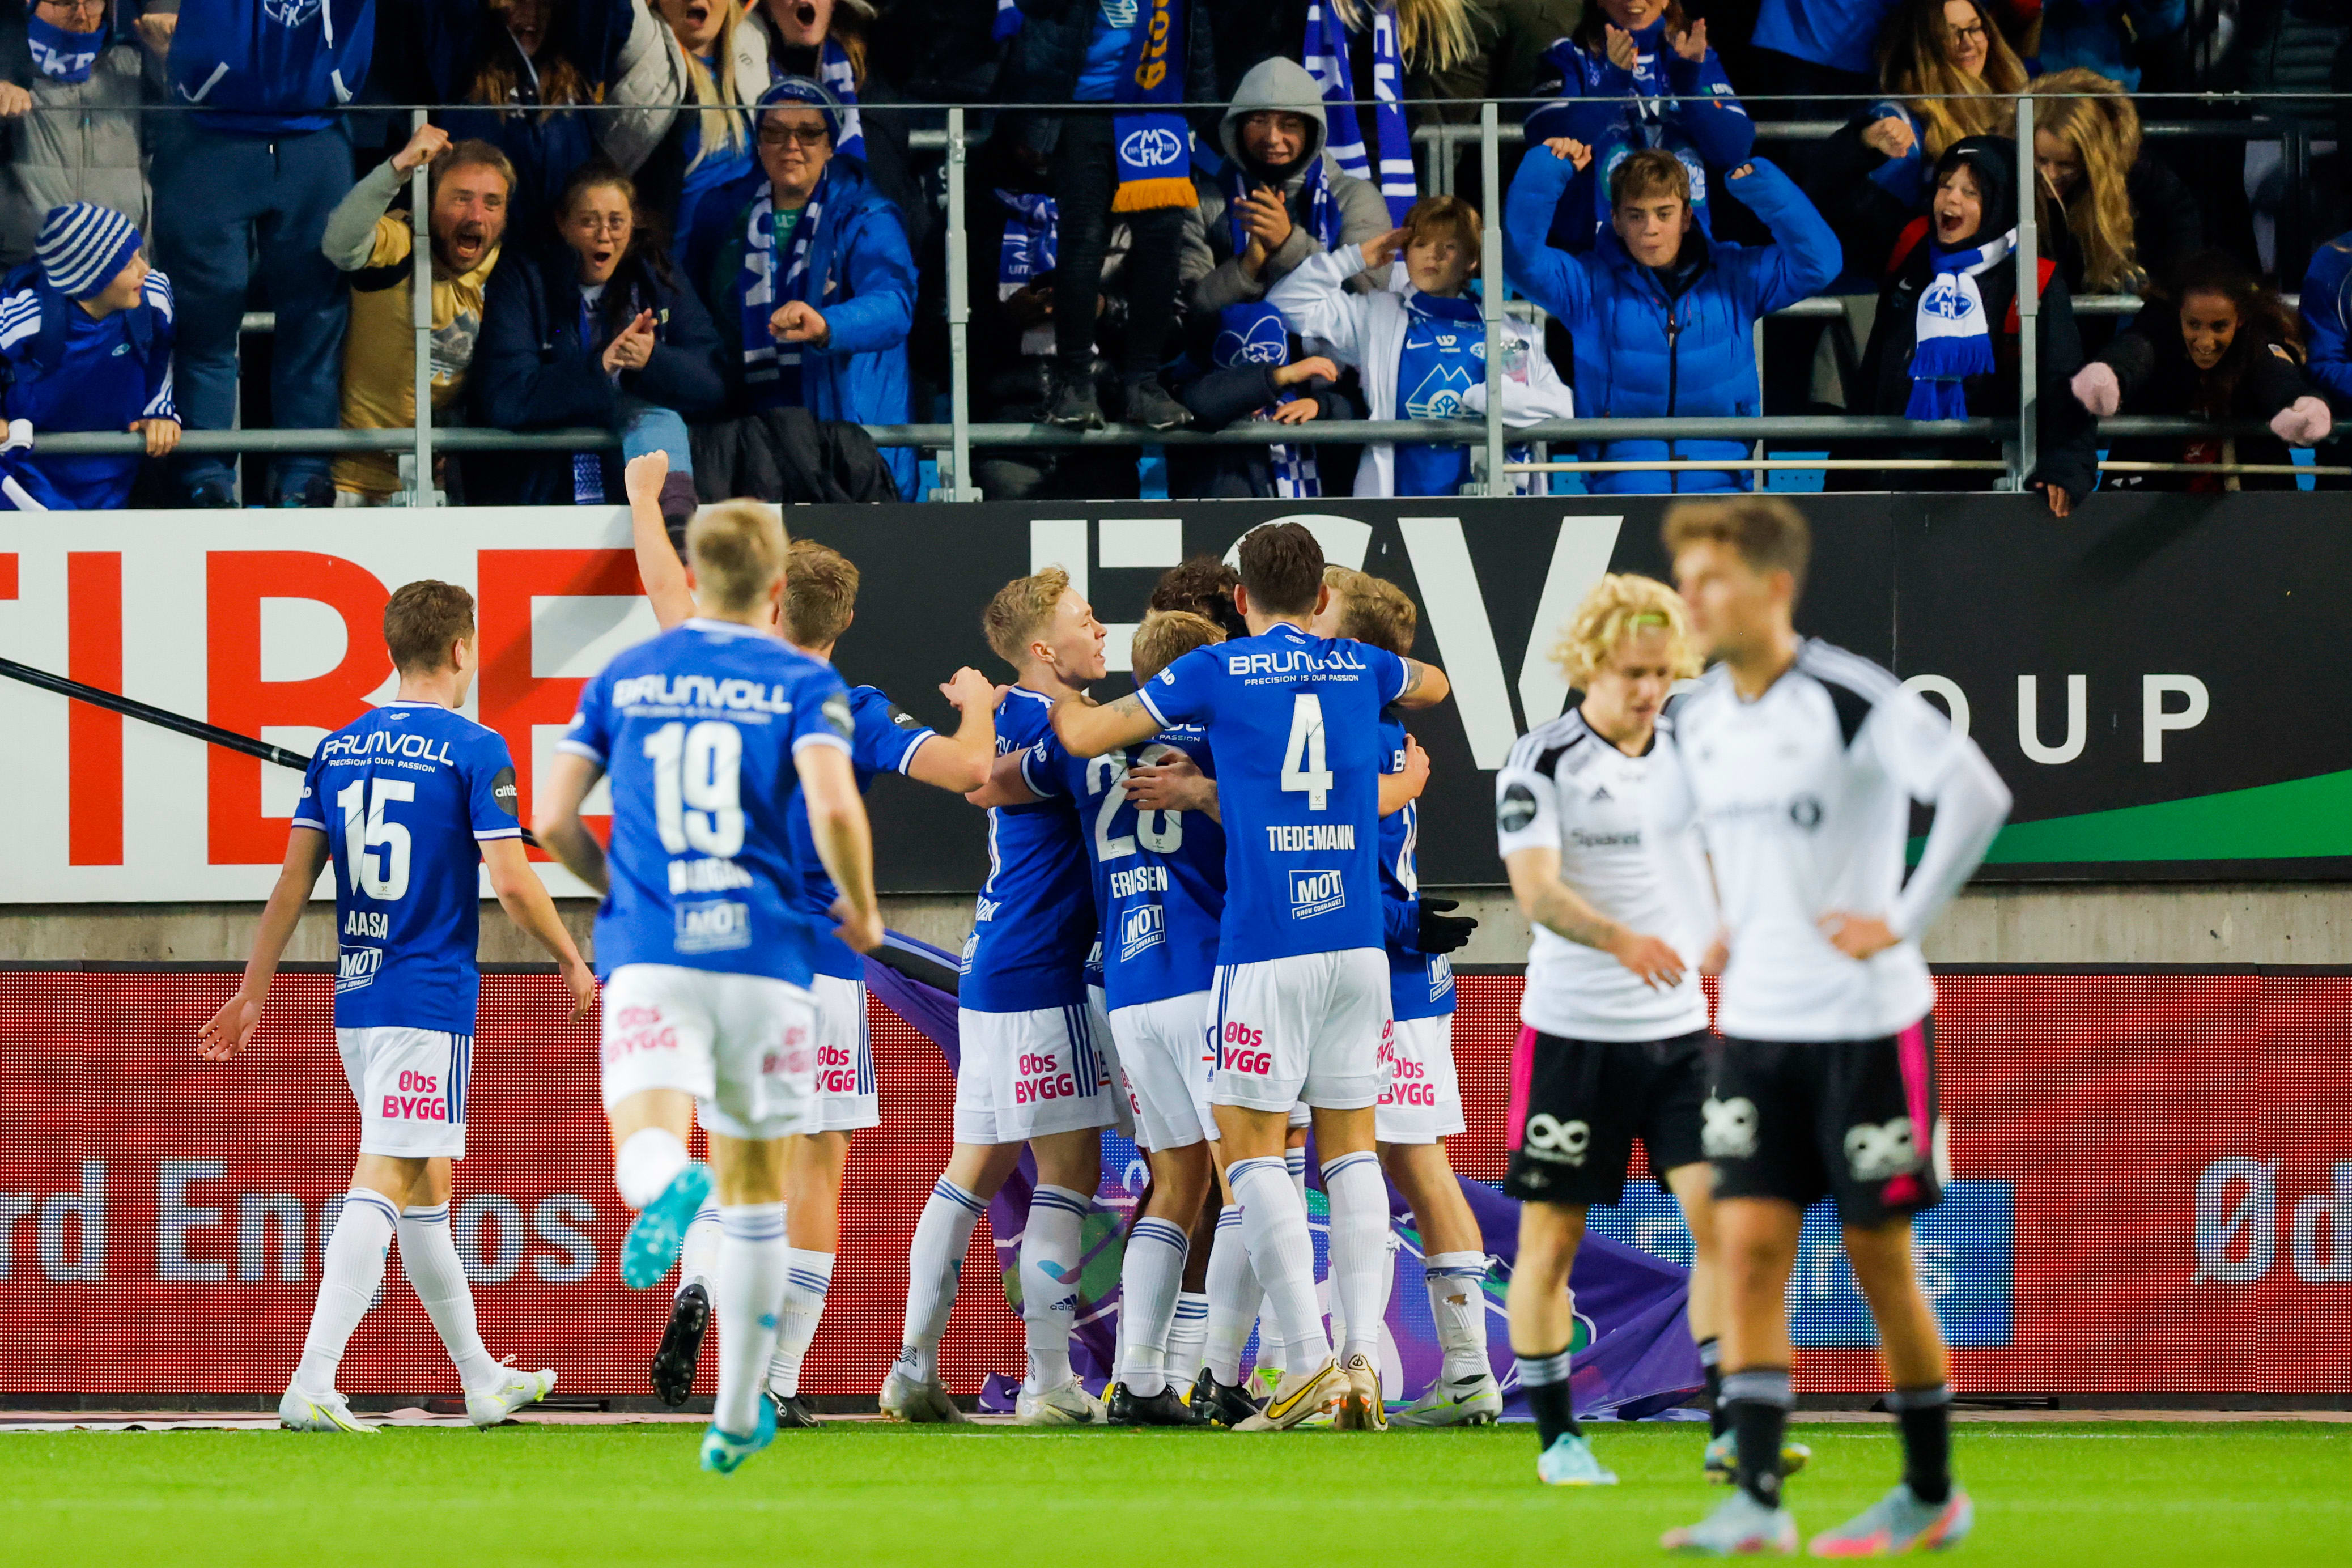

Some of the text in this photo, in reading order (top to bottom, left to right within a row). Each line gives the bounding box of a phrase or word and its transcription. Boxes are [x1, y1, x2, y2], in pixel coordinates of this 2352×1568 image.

[1229, 651, 1366, 675] BRUNVOLL
[613, 674, 792, 714] BRUNVOLL
[1245, 675, 1296, 686] PRECISION
[0, 549, 647, 866] IBE
[321, 730, 454, 766] BRUNVOLL
[1281, 694, 1333, 810] 4
[374, 758, 394, 767] OUR
[398, 760, 435, 773] PASSION
[643, 721, 744, 857] 19
[337, 777, 415, 900] 15
[1266, 825, 1355, 851] TIEDEMANN
[1297, 872, 1340, 902] MOT
[1296, 899, 1341, 917] SHOW COURAGE!
[345, 910, 388, 940] AASA
[1127, 906, 1161, 943] MOT
[340, 949, 383, 977] MOT
[1224, 1021, 1263, 1047] Obs
[817, 1045, 850, 1066] Obs
[1020, 1053, 1057, 1076] Obs
[1223, 1047, 1272, 1075] YGG
[399, 1070, 436, 1093] Obs
[1015, 1073, 1075, 1103] BYGG
[382, 1095, 445, 1120] BYGG
[158, 1156, 598, 1309] Enos
